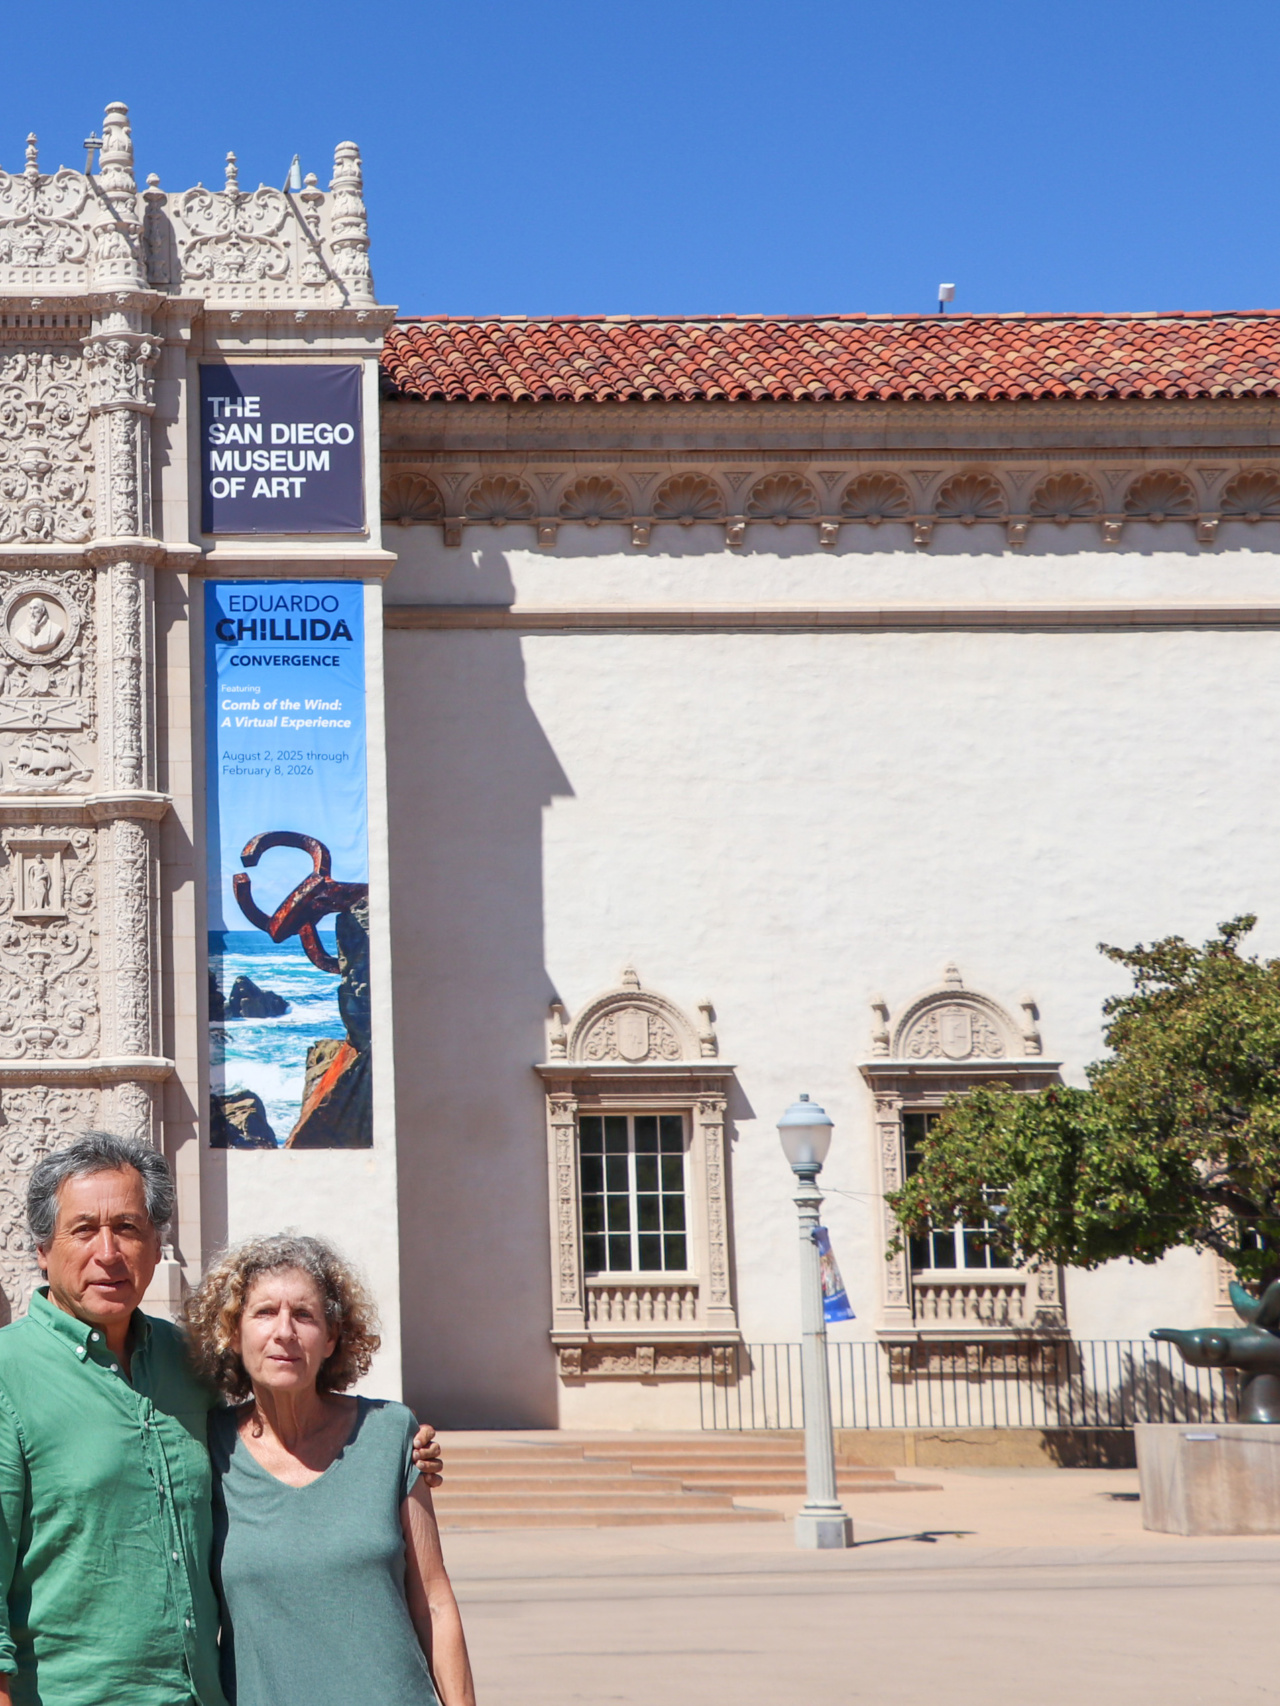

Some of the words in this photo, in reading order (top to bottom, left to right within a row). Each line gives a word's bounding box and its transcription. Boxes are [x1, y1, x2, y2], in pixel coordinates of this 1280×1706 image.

[207, 396, 261, 418] THE
[208, 423, 262, 445] SAN
[271, 422, 355, 445] DIEGO
[209, 450, 330, 472] MUSEUM
[209, 477, 246, 499] OF
[251, 477, 306, 498] ART
[229, 595, 339, 613] EDUARDO
[215, 618, 354, 642] CHILLIDA
[229, 655, 340, 667] CONVERGENCE
[221, 684, 261, 694] Featuring
[221, 698, 260, 711] Comb
[263, 698, 278, 711] of
[280, 698, 301, 711] the
[305, 698, 342, 711] Wind:
[221, 717, 232, 728] A
[235, 716, 277, 728] Virtual
[280, 716, 352, 730] Experience
[222, 751, 261, 763] August
[264, 751, 273, 763] 2,
[277, 751, 303, 761] 2025
[306, 750, 349, 763] through
[222, 765, 271, 777] February
[274, 766, 284, 776] 8,
[287, 766, 314, 776] 2026
